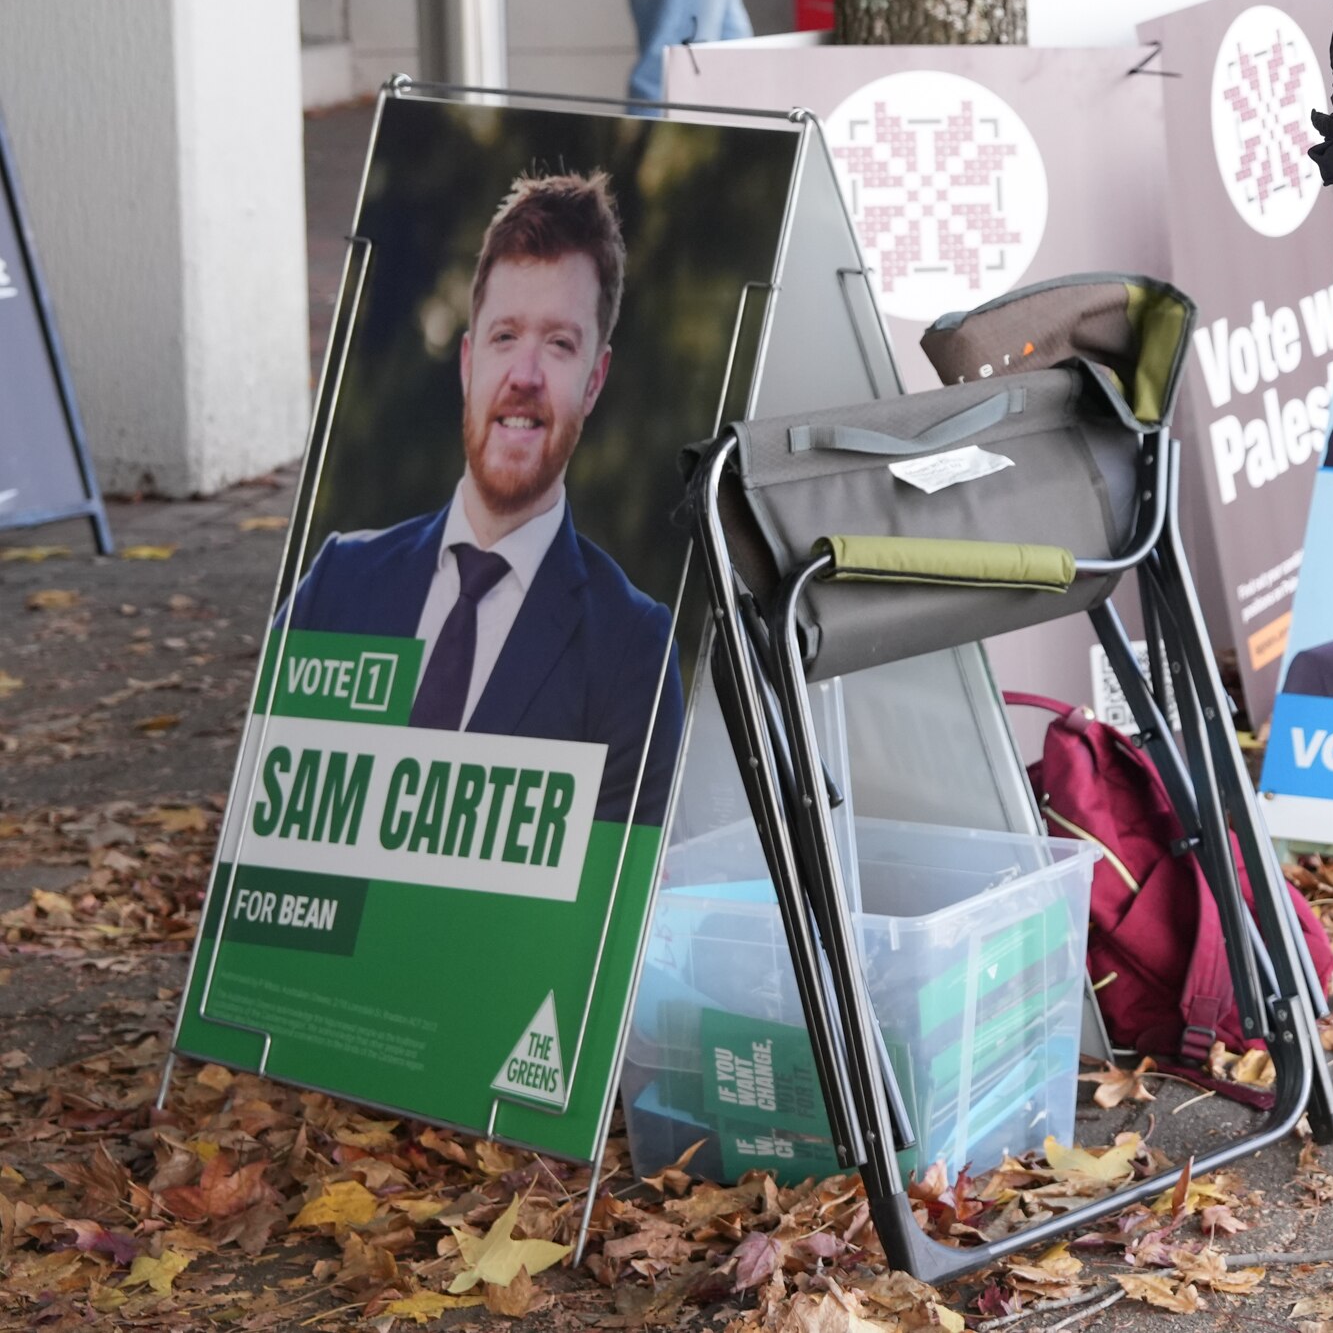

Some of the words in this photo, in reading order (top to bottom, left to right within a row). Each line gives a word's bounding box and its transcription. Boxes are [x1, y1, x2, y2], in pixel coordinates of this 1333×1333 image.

[1193, 299, 1301, 408] Vote
[288, 656, 355, 698] VOTE
[368, 663, 381, 700] 1
[252, 745, 375, 846] SAM
[378, 756, 576, 868] CARTER
[233, 888, 277, 924] FOR
[277, 893, 338, 931] BEAN
[528, 1031, 554, 1061] THE
[714, 1047, 736, 1083] YOU
[507, 1057, 559, 1093] GREENS
[718, 1085, 738, 1104] IF
[734, 1056, 757, 1107] WANT
[751, 1039, 776, 1112] CHANGE,
[736, 1138, 756, 1155] IF
